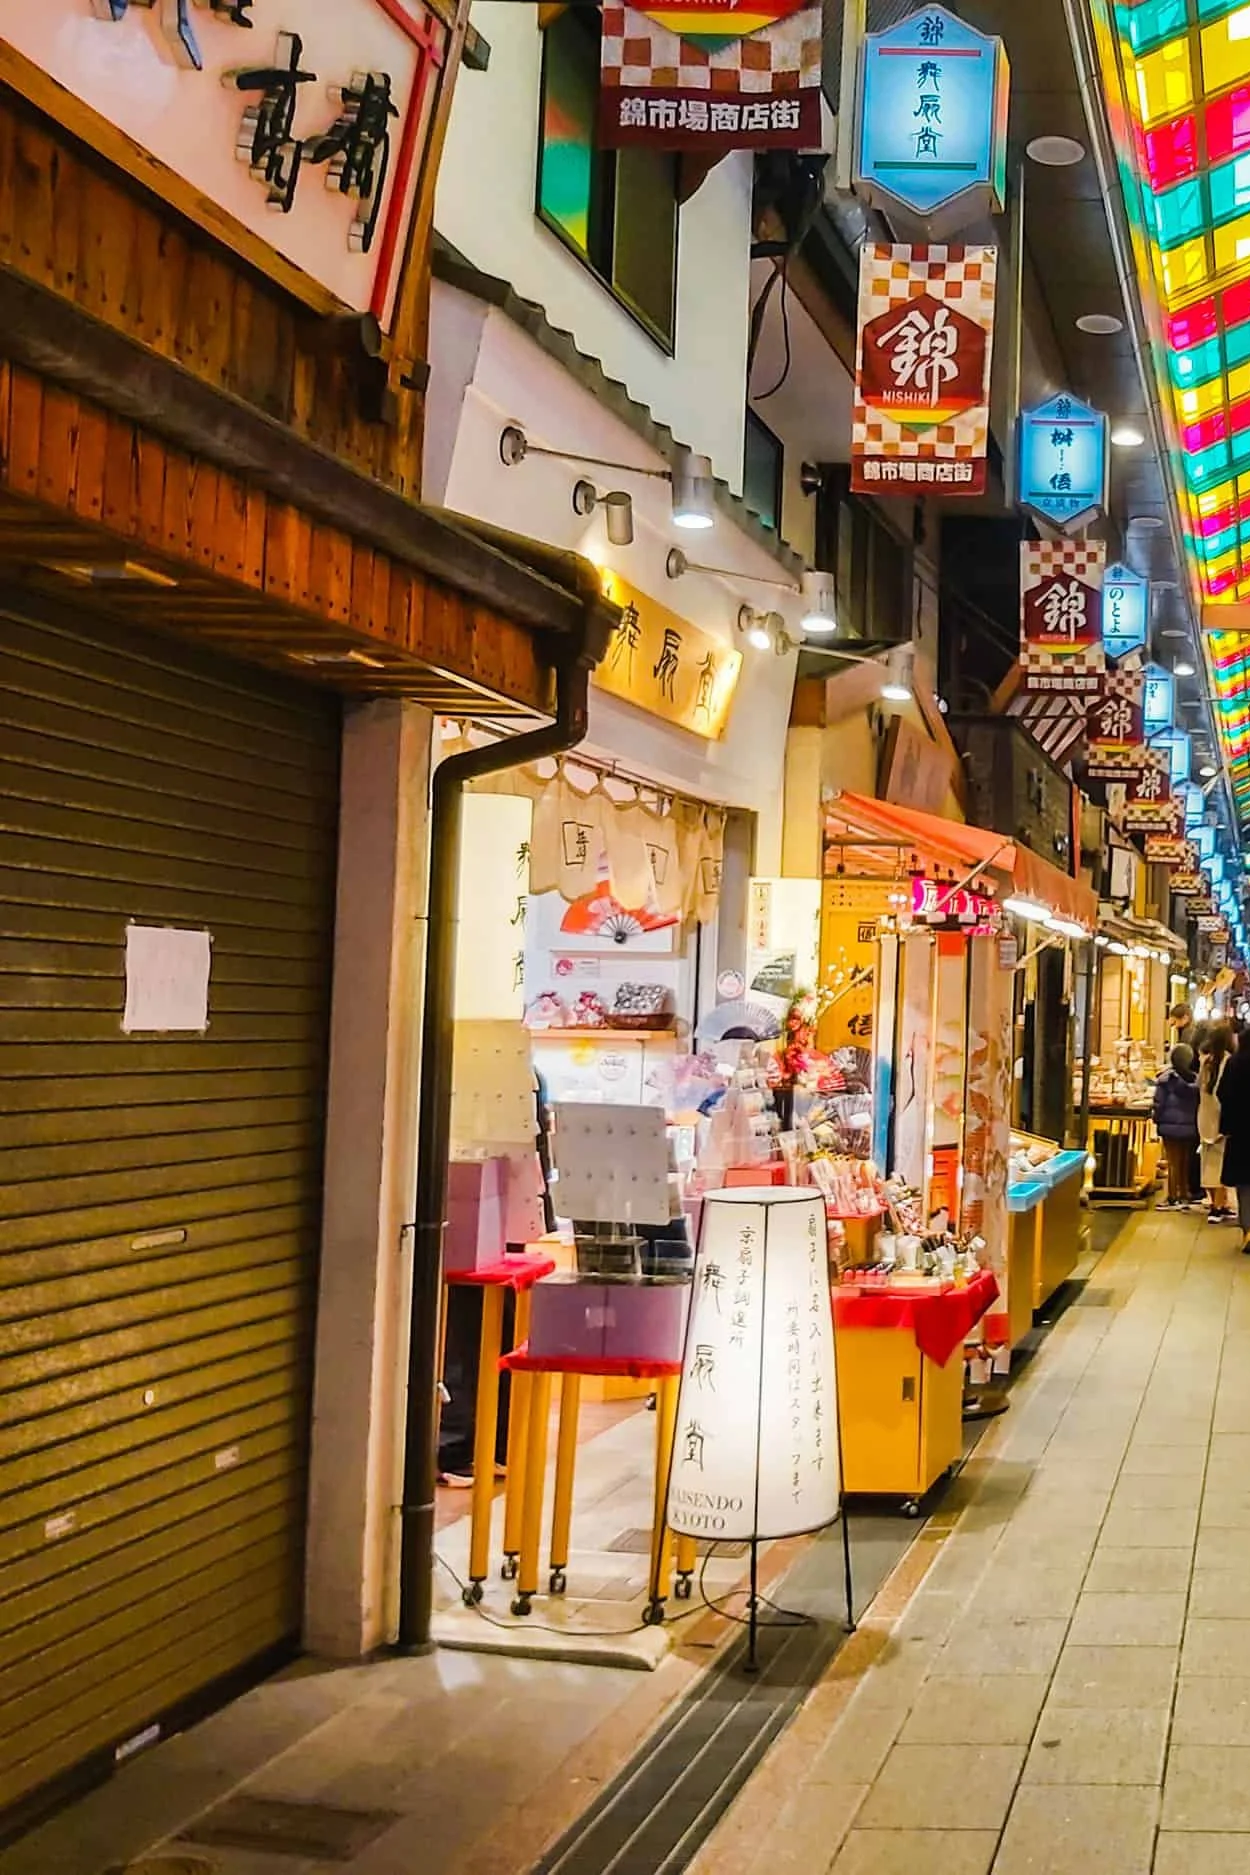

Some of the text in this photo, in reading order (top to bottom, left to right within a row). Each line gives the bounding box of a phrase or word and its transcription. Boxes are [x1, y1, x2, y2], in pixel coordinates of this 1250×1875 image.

[917, 16, 943, 45] 錦
[620, 99, 799, 132] 錦市場商店街
[876, 309, 958, 408] 錦
[882, 390, 930, 405] NISHIKI
[864, 461, 972, 482] 錦市場商店街
[1034, 581, 1086, 642] 錦
[1095, 699, 1132, 744] 錦
